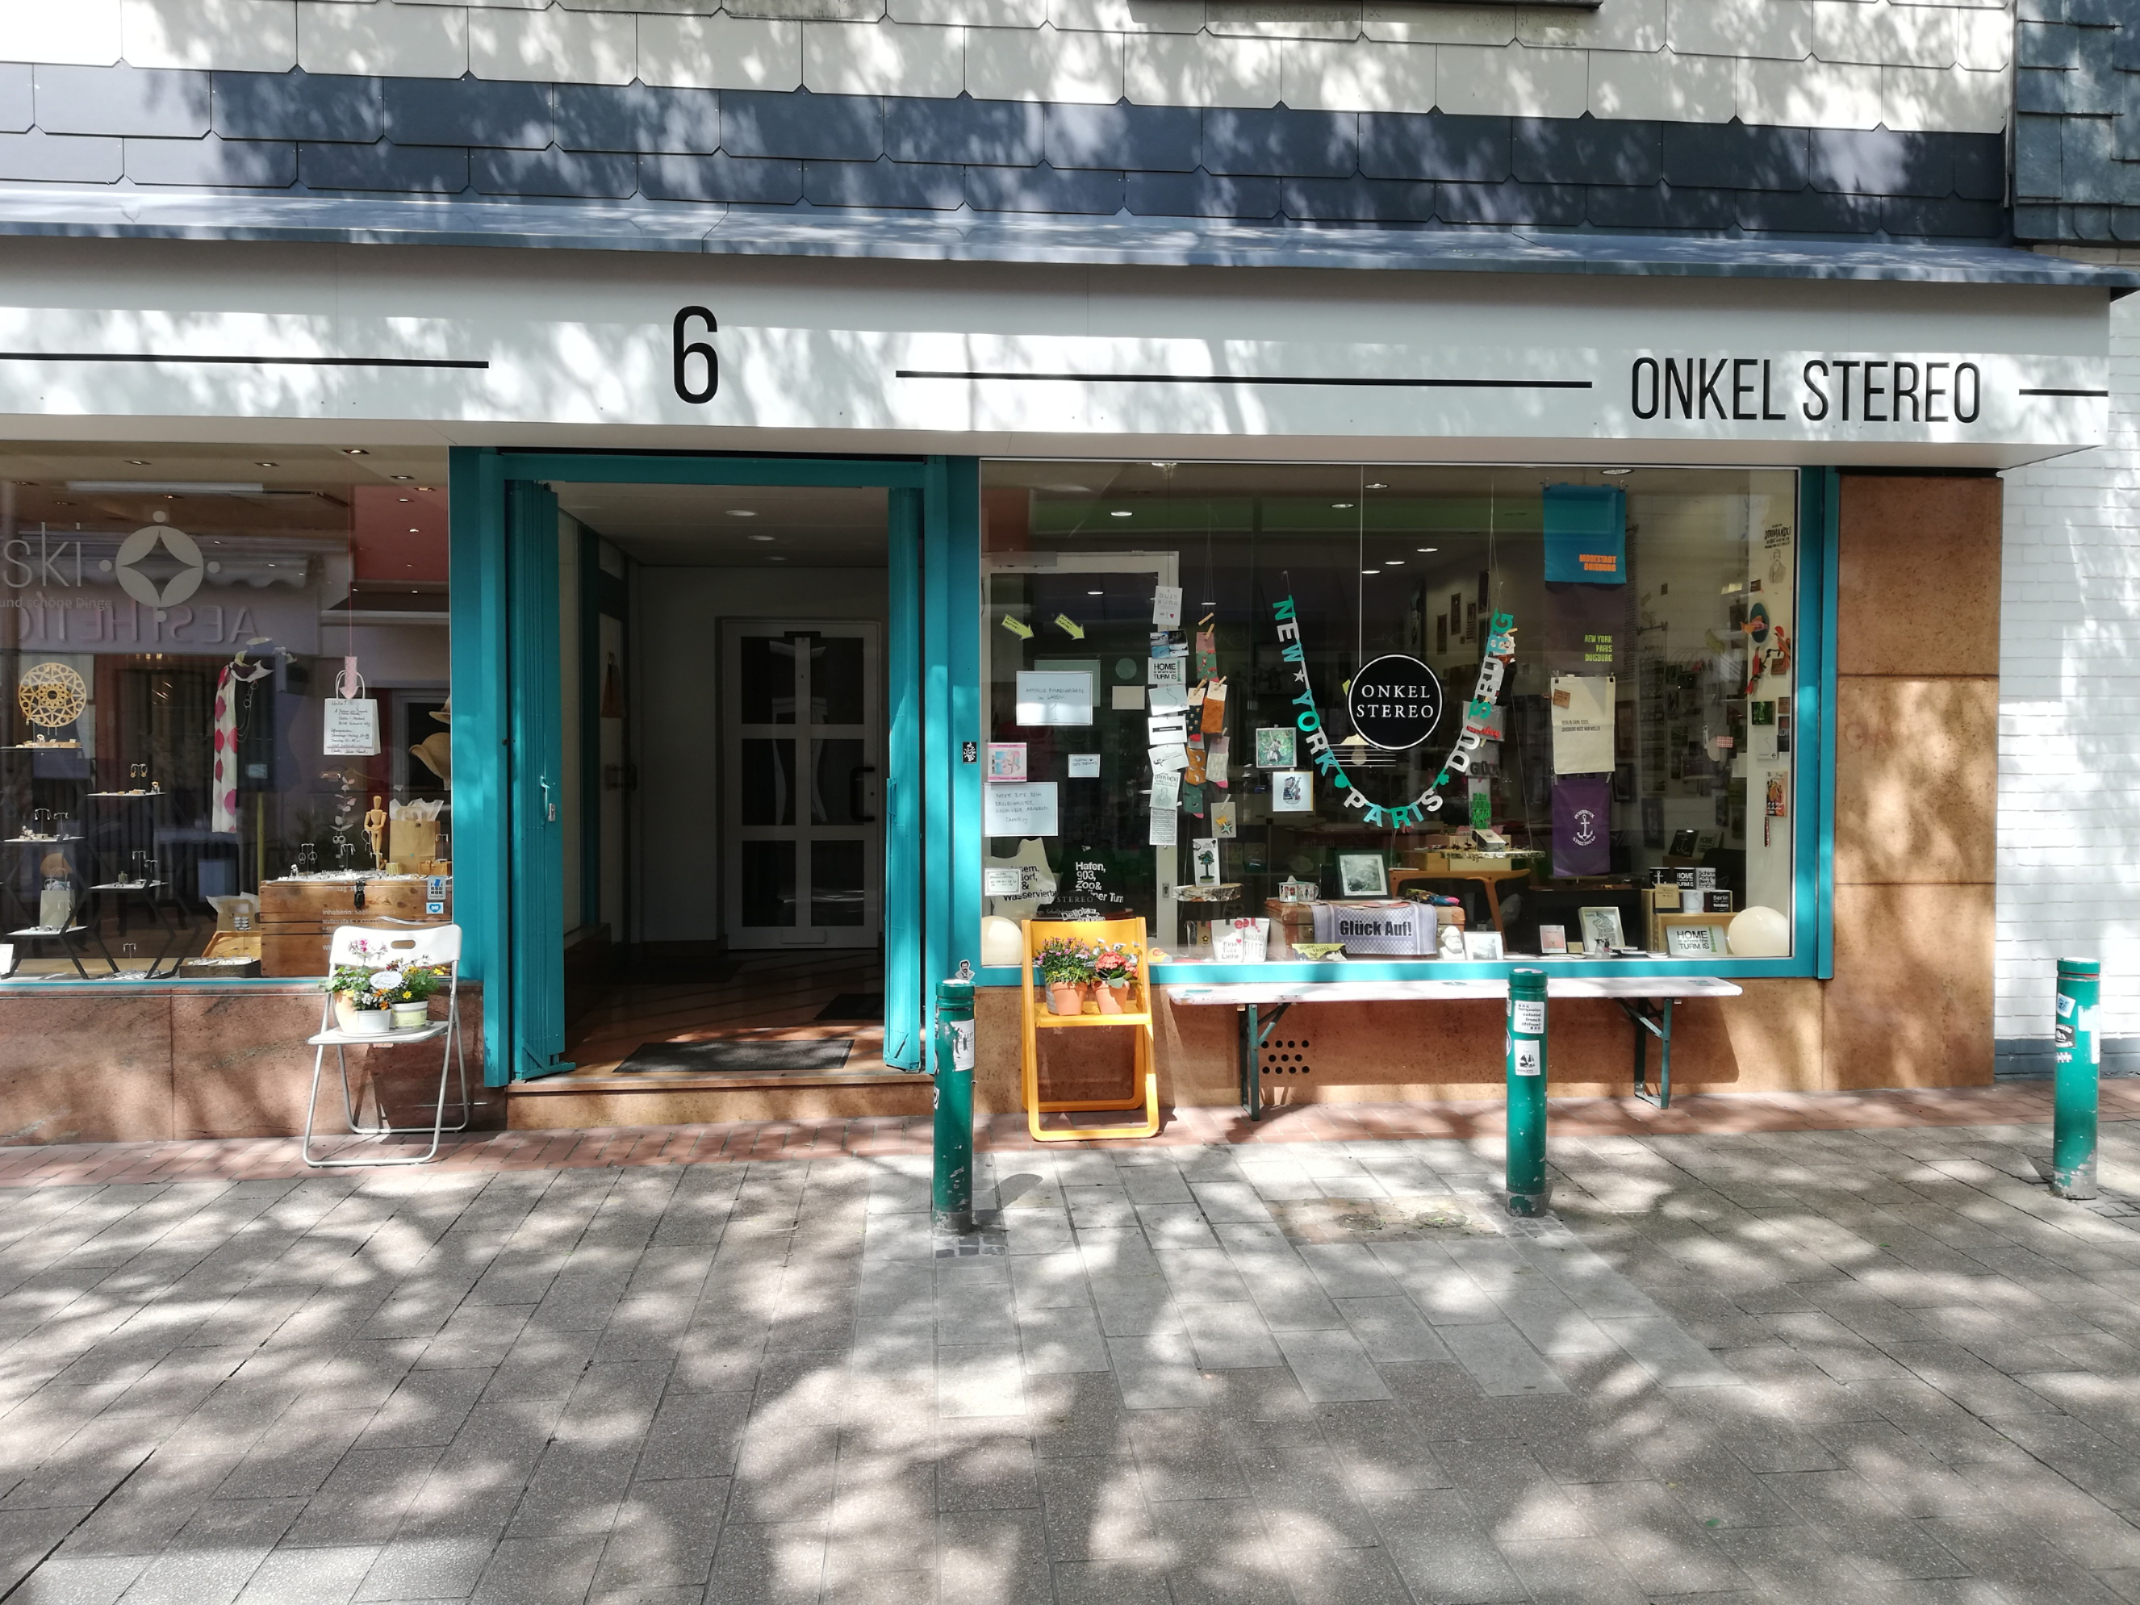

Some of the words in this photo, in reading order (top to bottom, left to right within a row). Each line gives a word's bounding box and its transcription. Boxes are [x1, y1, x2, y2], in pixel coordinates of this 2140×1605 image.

[673, 306, 718, 404] 6
[1632, 357, 1786, 420] ONKEL
[1802, 359, 1981, 424] STEREO
[3, 522, 82, 588] ski
[76, 597, 112, 611] Dinge
[1584, 635, 1596, 643] NEW
[1597, 635, 1613, 643] YORK
[1585, 654, 1613, 662] DUISBURG
[1154, 663, 1176, 671] HOME
[1361, 685, 1431, 699] ONKEL
[1273, 597, 1304, 662] NEW
[1292, 689, 1338, 776] YORK
[1344, 787, 1443, 828] PARIS
[1356, 705, 1434, 719] STEREO
[1075, 862, 1106, 872] Hafen,
[1076, 871, 1097, 881] 903,
[1340, 920, 1381, 936] Glück
[1384, 920, 1412, 937] Auf!
[1677, 930, 1708, 939] HOME
